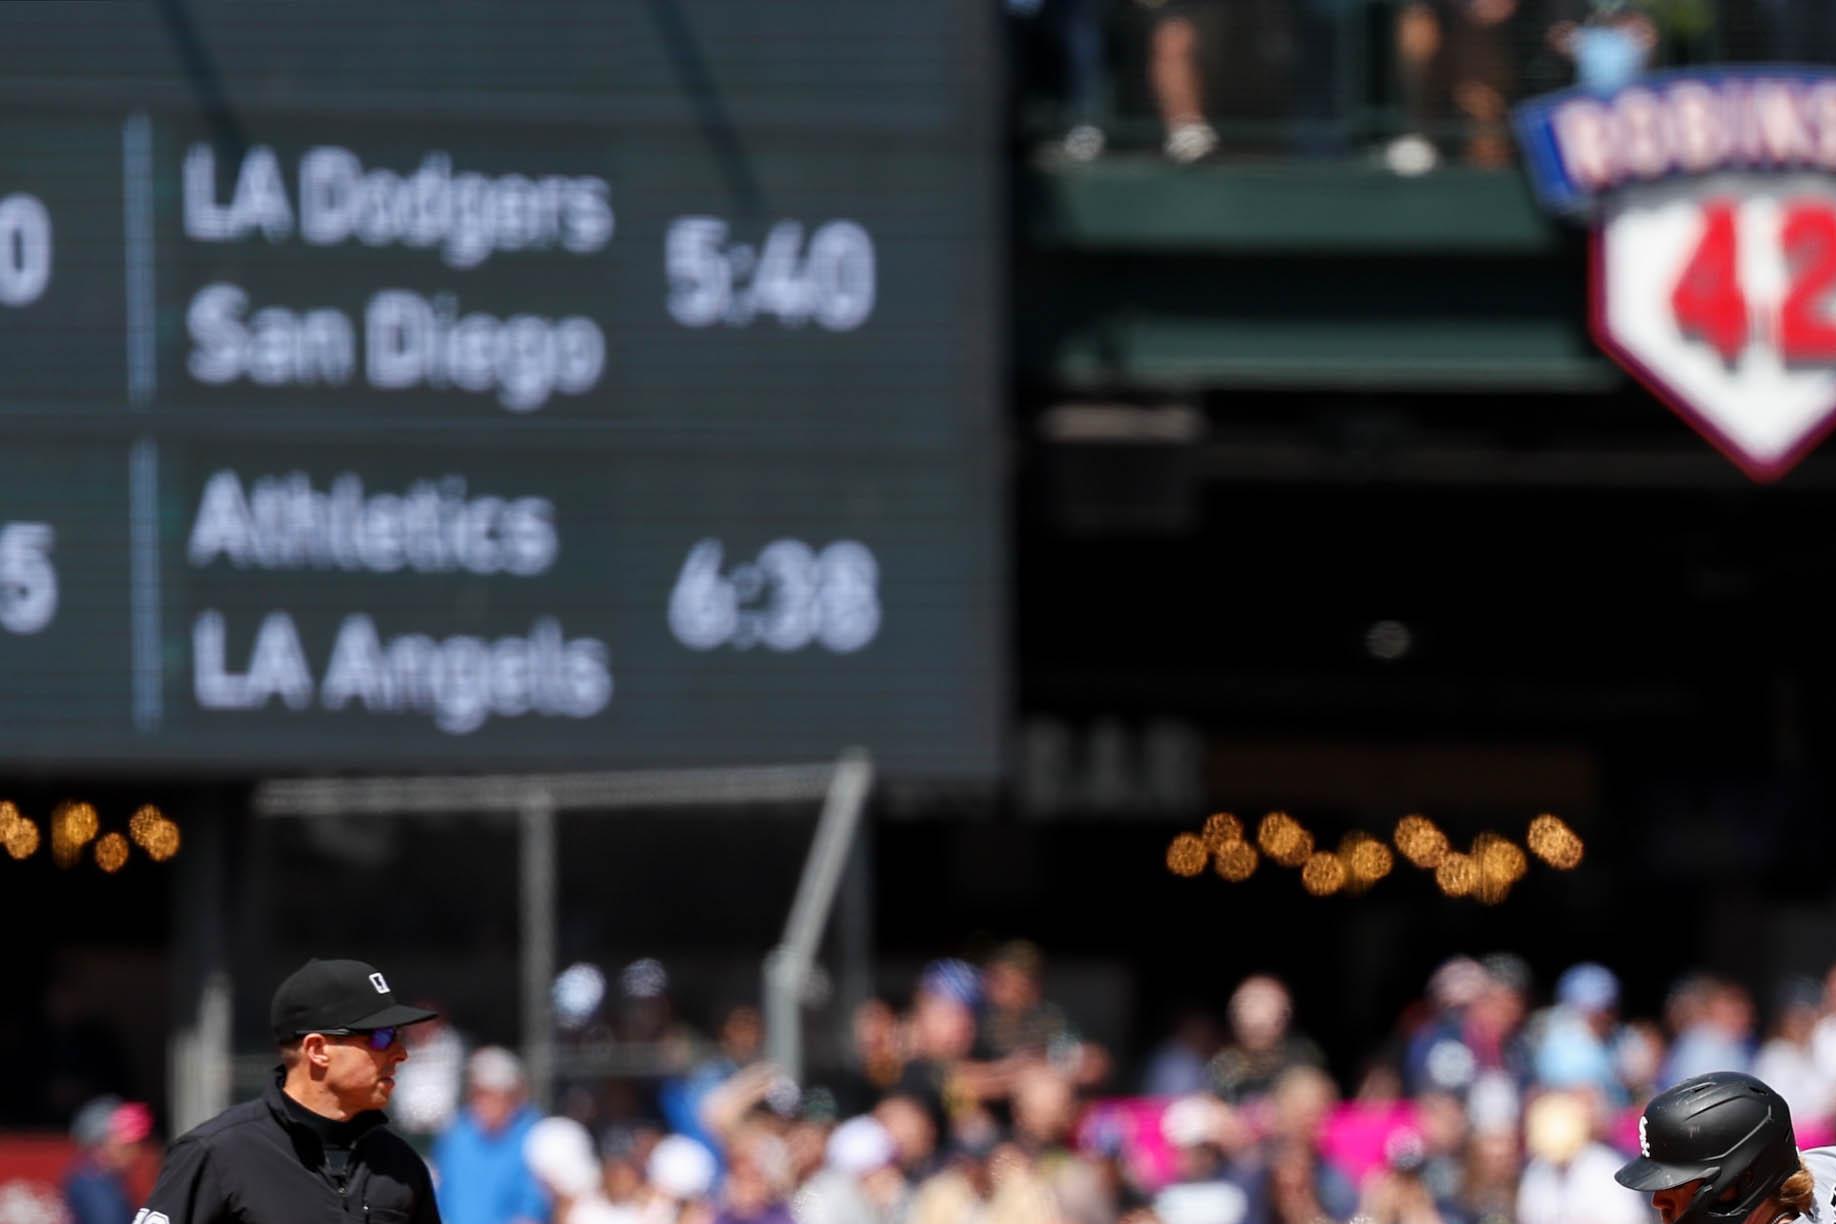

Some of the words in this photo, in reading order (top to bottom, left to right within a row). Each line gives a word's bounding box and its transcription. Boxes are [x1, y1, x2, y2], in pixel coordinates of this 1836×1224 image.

[182, 145, 294, 241] LA
[298, 145, 615, 269] Dodgers
[665, 216, 877, 331] 5:40
[187, 284, 357, 386] San
[364, 289, 606, 411] Diego
[189, 471, 559, 576] Athletics
[667, 538, 882, 653] 6:38
[193, 611, 313, 710] LA
[321, 614, 613, 734] Angels
